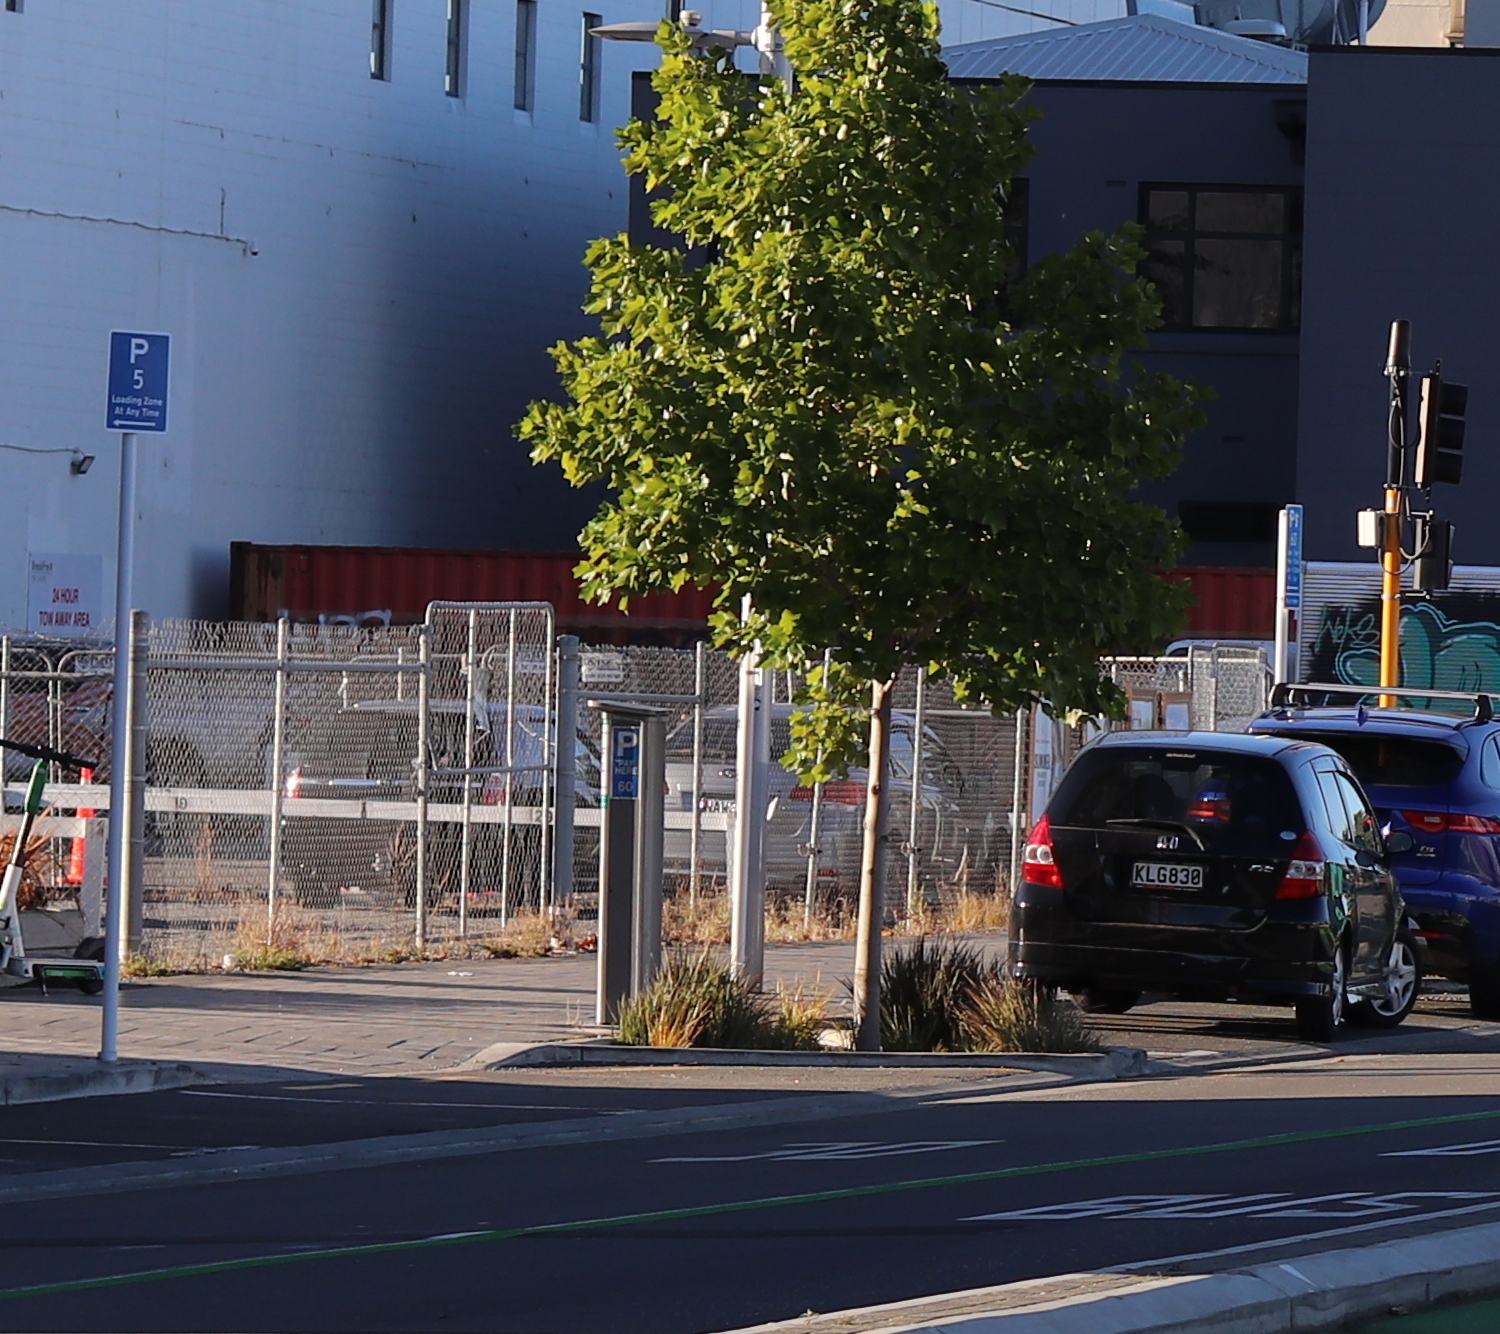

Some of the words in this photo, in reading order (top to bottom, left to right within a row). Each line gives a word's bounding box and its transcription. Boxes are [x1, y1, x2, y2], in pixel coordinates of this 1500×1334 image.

[130, 338, 149, 364] P
[133, 370, 144, 389] 5
[112, 395, 142, 406] Loading
[143, 396, 163, 406] Zone
[114, 406, 124, 415] At
[126, 407, 140, 417] Any
[142, 408, 160, 417] Time
[52, 588, 60, 603] 24
[60, 588, 79, 604] HOUR
[39, 611, 54, 626] TOW
[54, 612, 73, 627] AWAY
[73, 612, 90, 627] AREA
[617, 732, 637, 756] P
[614, 766, 638, 775] HERE
[618, 781, 633, 792] 60
[1134, 865, 1201, 885] KLG830
